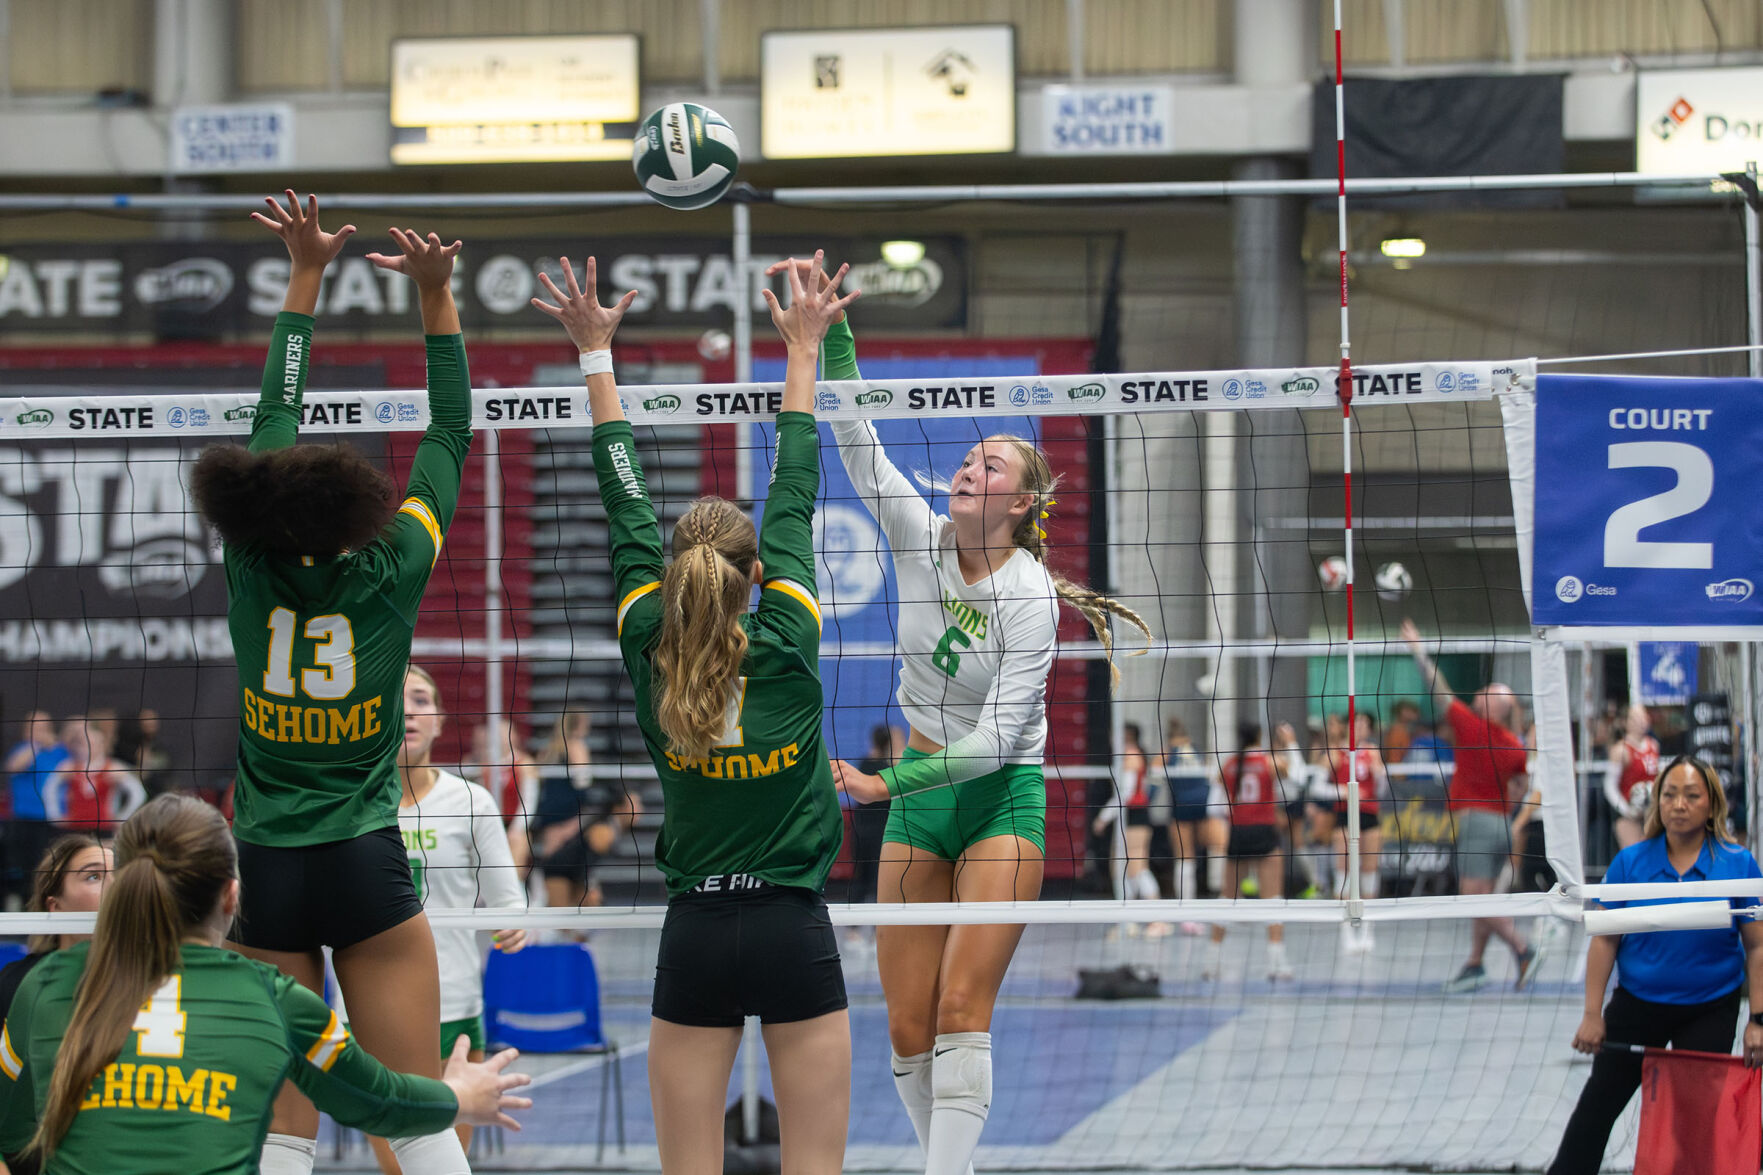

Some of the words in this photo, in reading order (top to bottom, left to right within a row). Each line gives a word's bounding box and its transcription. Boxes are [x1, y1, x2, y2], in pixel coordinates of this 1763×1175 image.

[283, 334, 303, 405] MARINERS
[818, 391, 836, 399] Gesa
[1031, 385, 1049, 393] Gesa
[1120, 379, 1208, 403] STATE
[1335, 372, 1422, 396] TATE
[485, 397, 572, 421] STATE
[696, 391, 783, 415] STATE
[908, 386, 995, 410] STATE
[69, 407, 153, 430] STATE
[300, 403, 362, 425] TATE
[1608, 407, 1714, 431] COURT
[1603, 441, 1714, 570] 2
[1585, 583, 1618, 597] Gesa
[263, 605, 357, 700] 13
[931, 625, 971, 678] 6
[244, 687, 382, 745] SEHOME
[131, 974, 188, 1059] 4
